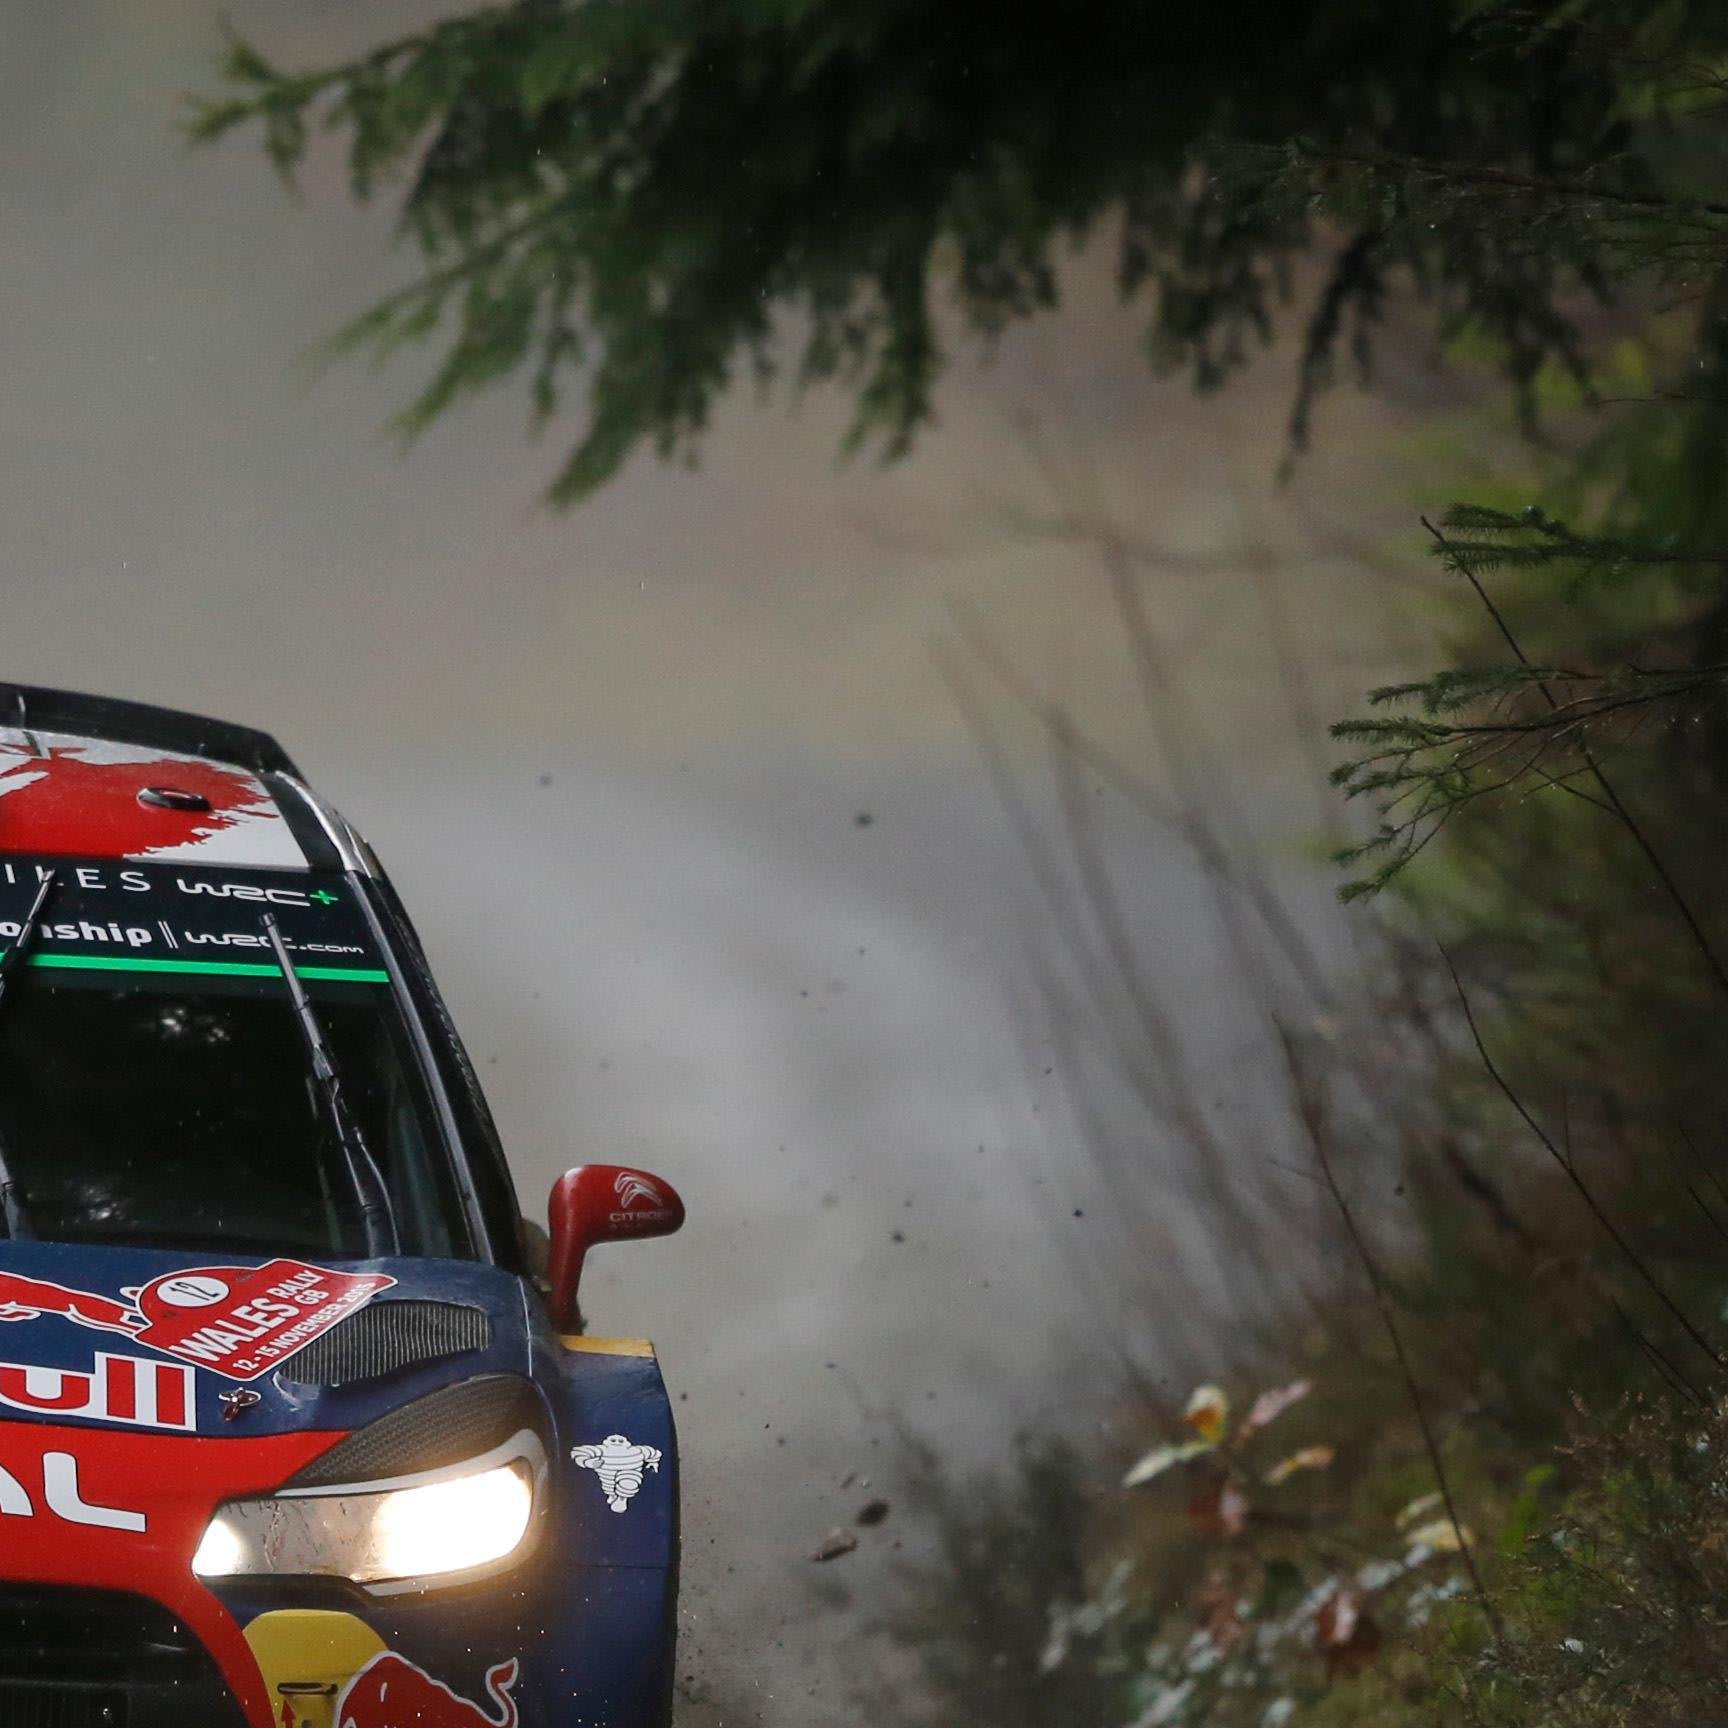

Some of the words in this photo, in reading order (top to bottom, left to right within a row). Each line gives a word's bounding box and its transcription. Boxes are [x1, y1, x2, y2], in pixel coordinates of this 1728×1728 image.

[169, 1281, 220, 1301] 12
[295, 1289, 330, 1305] GB
[170, 1298, 300, 1361] WALES
[266, 1270, 324, 1298] RALLY
[269, 1301, 343, 1349] NOVEMBER
[337, 1281, 376, 1308] 2015
